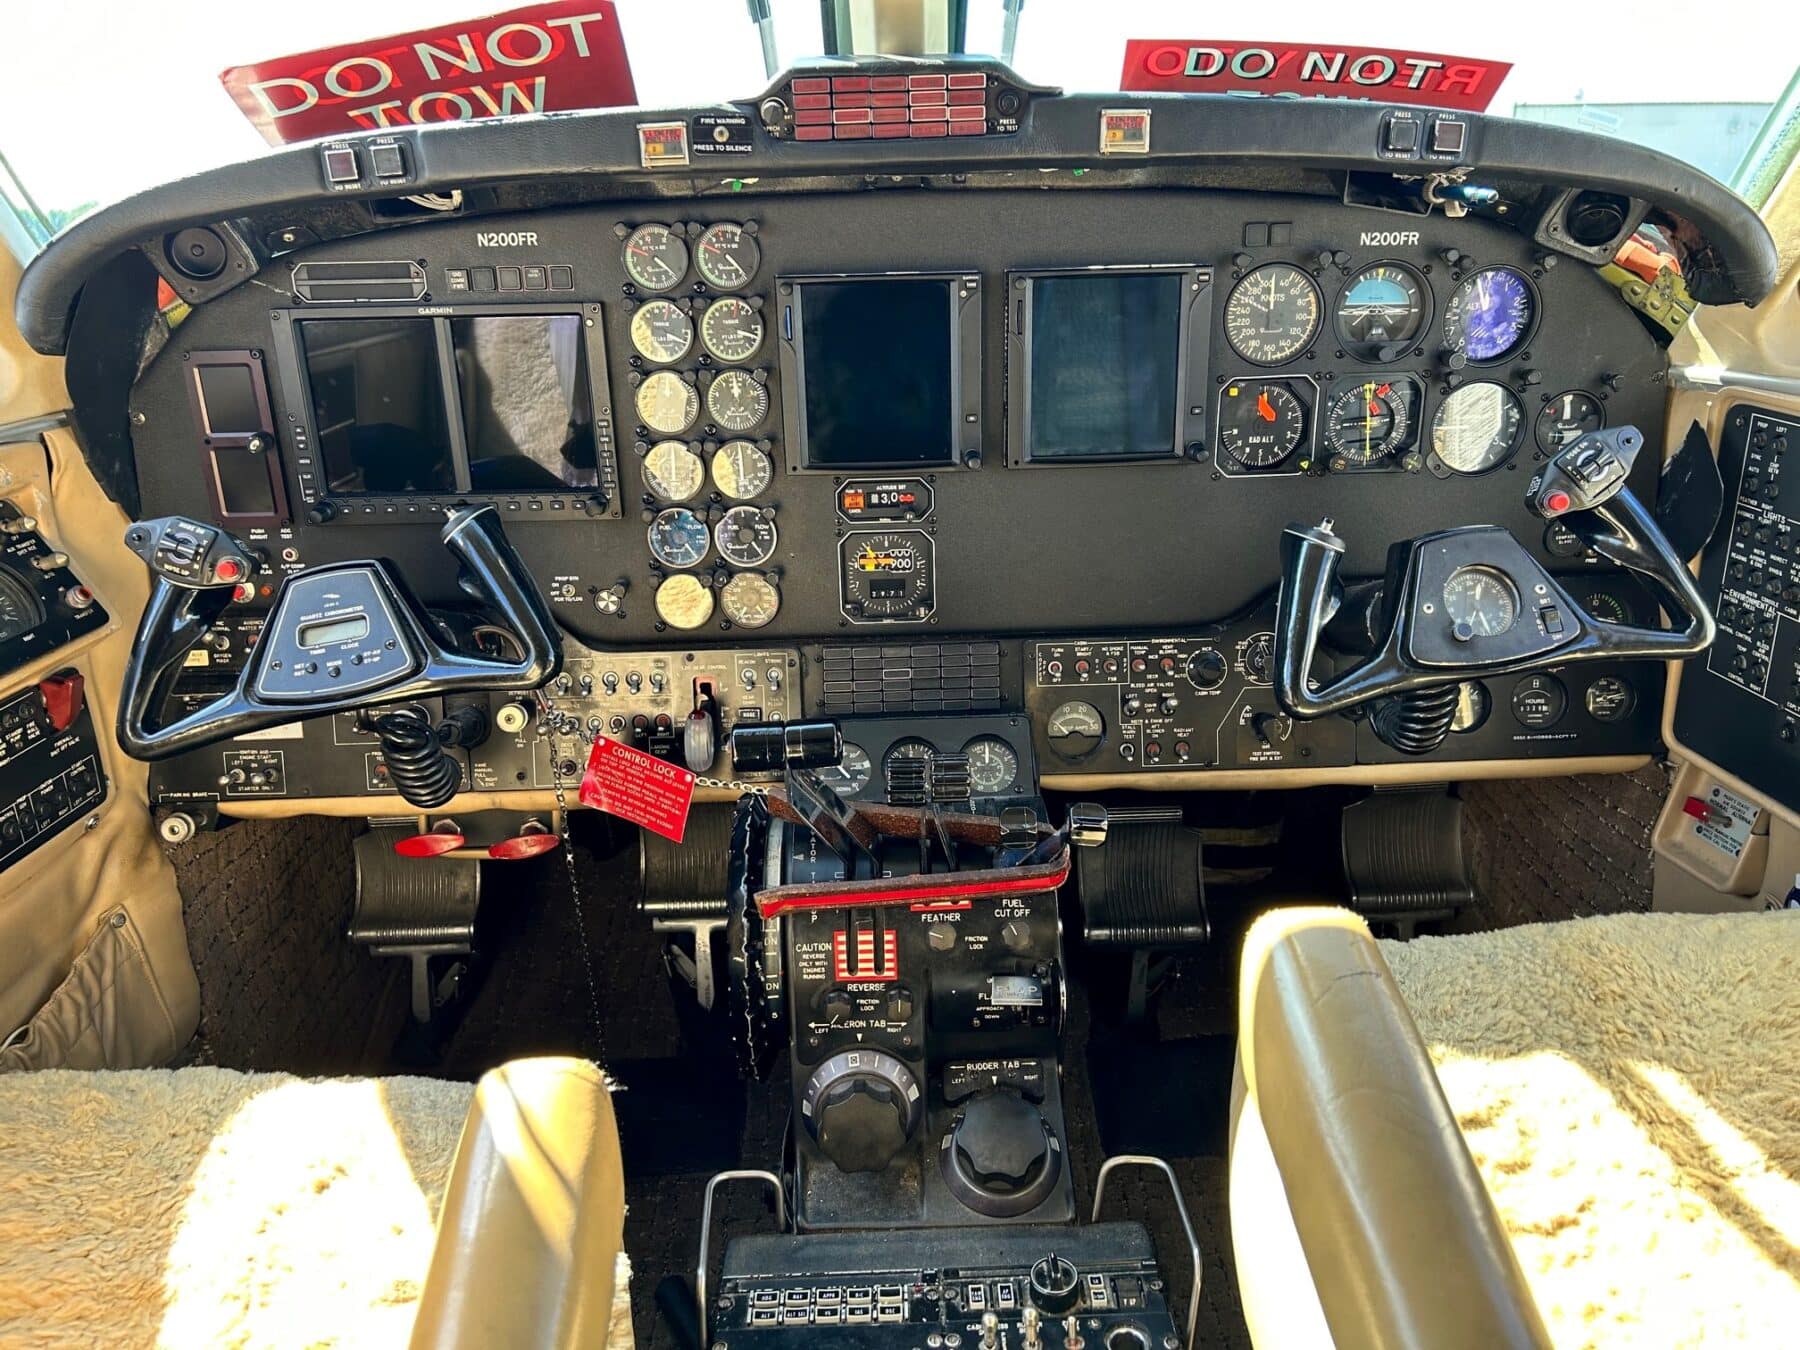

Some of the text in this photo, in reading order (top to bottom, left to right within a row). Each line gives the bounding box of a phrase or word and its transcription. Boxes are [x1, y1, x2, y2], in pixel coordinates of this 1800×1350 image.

[249, 13, 603, 119] DO NOT
[1184, 47, 1443, 90] DO NOT
[347, 76, 546, 128] TOW
[476, 231, 538, 247] N200FR
[1360, 231, 1420, 247] N200FR
[1465, 285, 1472, 294] 9
[1505, 282, 1509, 292] 1
[1452, 297, 1459, 307] 8
[1514, 296, 1520, 306] 2
[1289, 327, 1301, 335] 120
[1449, 326, 1455, 336] 7
[1459, 337, 1465, 346] 6
[1287, 411, 1292, 419] 2
[1261, 435, 1274, 443] ALT
[1763, 510, 1786, 524] LIGHTS
[1729, 589, 1776, 615] ENVIRONMENTAL
[611, 746, 677, 778] CONTROL LOCK
[1002, 899, 1025, 907] FUEL
[921, 913, 961, 922] FEATHER
[994, 909, 1030, 917] CUT OFF
[764, 936, 778, 946] DN
[795, 943, 832, 951] CAUTION
[765, 982, 779, 991] DN
[847, 983, 886, 992] REVERSE
[831, 1020, 886, 1029] ERON TAB
[966, 1061, 1020, 1071] RUDDER TAB
